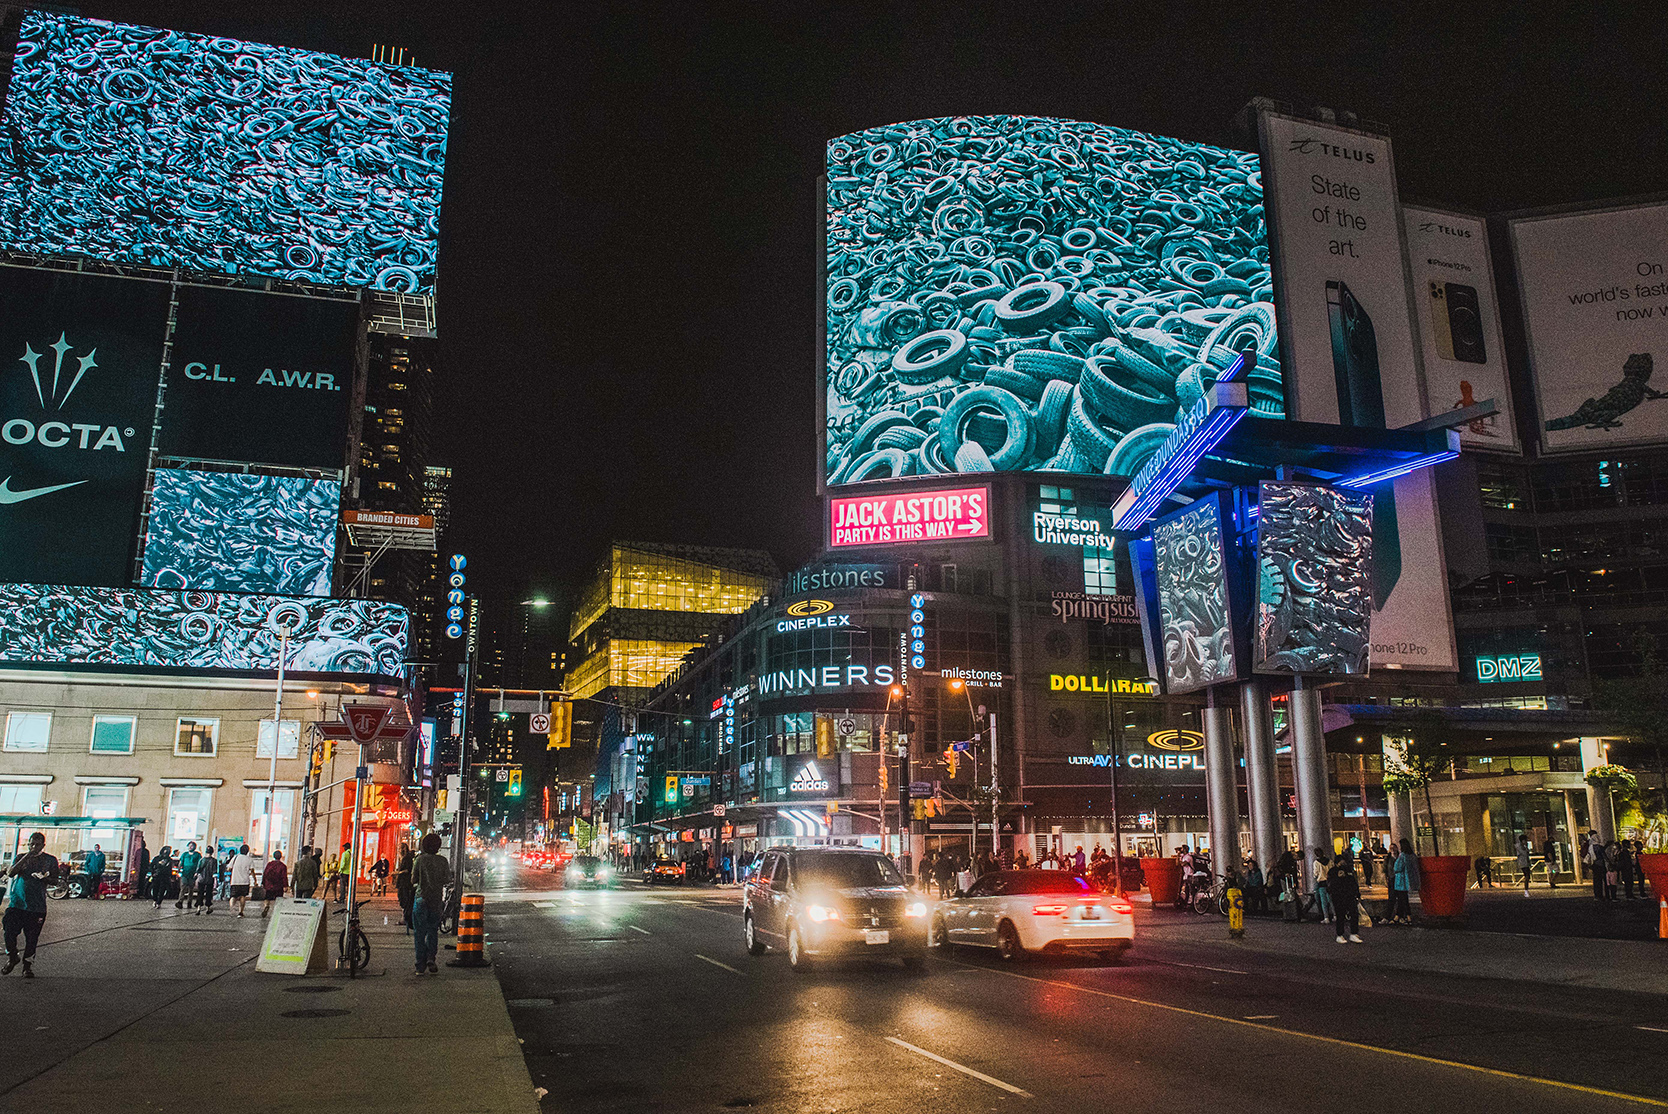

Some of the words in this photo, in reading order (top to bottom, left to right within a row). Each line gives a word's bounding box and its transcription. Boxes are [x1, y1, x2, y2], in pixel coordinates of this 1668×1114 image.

[1320, 142, 1375, 164] TELUS
[1311, 174, 1361, 201] State
[1312, 206, 1331, 224] of
[1336, 208, 1367, 231] the
[1438, 225, 1471, 238] TELUS
[1329, 240, 1360, 258] art.
[1636, 262, 1663, 277] On
[1568, 286, 1630, 305] world's
[1616, 307, 1653, 321] now
[184, 362, 236, 383] C.L.
[256, 368, 341, 391] A.W.R.
[357, 513, 393, 524] BRANDED
[394, 515, 420, 526] CITIES
[836, 501, 888, 528] JACK
[893, 493, 982, 524] ASTOR'S
[836, 526, 876, 543] PARTY
[880, 525, 891, 541] IS
[894, 523, 923, 540] THIS
[925, 521, 955, 537] WAY
[1034, 512, 1100, 532] Ryerson
[1035, 527, 1115, 551] University
[785, 564, 885, 594] ilestones
[445, 554, 467, 639] Yonge
[777, 614, 850, 633] CINEPLEX
[911, 594, 925, 669] Yonge
[900, 632, 908, 686] DOWNTOWN
[1397, 642, 1407, 654] 12
[1409, 643, 1428, 656] Pro
[758, 664, 894, 695] WINNERS
[941, 666, 1003, 680] milestones
[1477, 657, 1543, 680] DMZ
[790, 780, 829, 791] adidas
